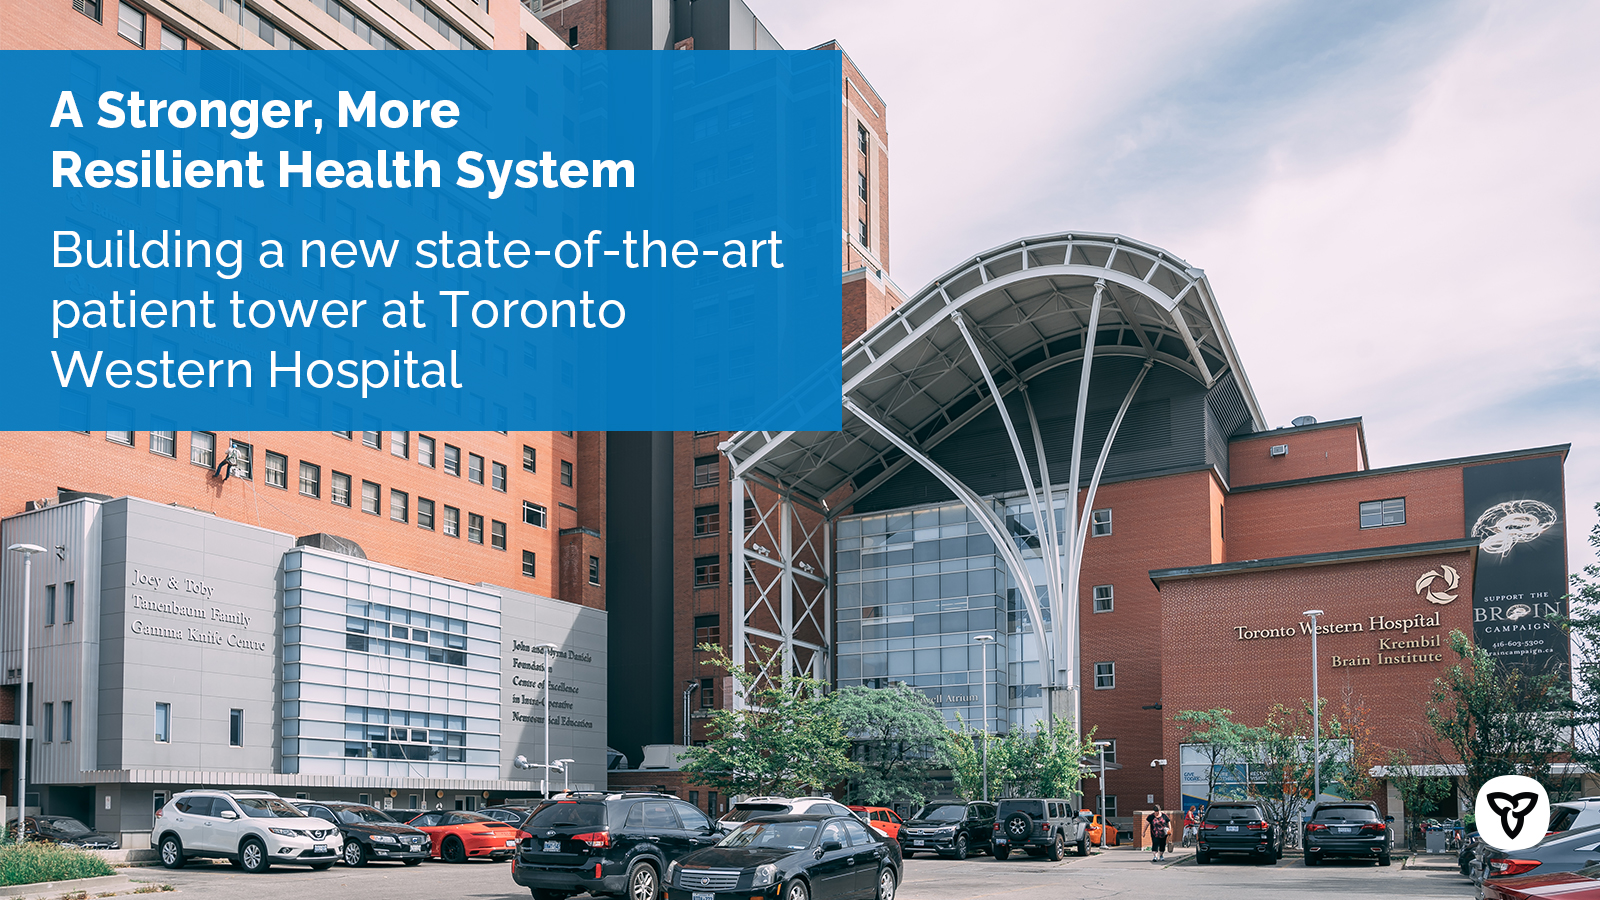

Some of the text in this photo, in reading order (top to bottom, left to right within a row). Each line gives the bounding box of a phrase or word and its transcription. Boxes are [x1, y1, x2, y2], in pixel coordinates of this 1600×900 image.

[131, 569, 214, 599] Joey & Toby
[1484, 591, 1549, 602] SUPPORT THE
[132, 594, 251, 629] Tanenbaum Family
[1234, 612, 1441, 640] Toronto Western Hospital
[1485, 622, 1550, 633] CAMPAIGN
[131, 620, 265, 651] Gamma Knife Centre
[1379, 634, 1441, 650] Krembil
[512, 640, 530, 652] John
[568, 650, 592, 662] Daniels
[1492, 639, 1545, 649] 416-603-5300
[512, 658, 552, 673] Foundatin
[1332, 652, 1443, 668] Brain Institute
[512, 676, 536, 688] Centre
[512, 694, 520, 704] in
[946, 693, 979, 703] Atrium
[512, 711, 593, 728] Neurosurical Education
